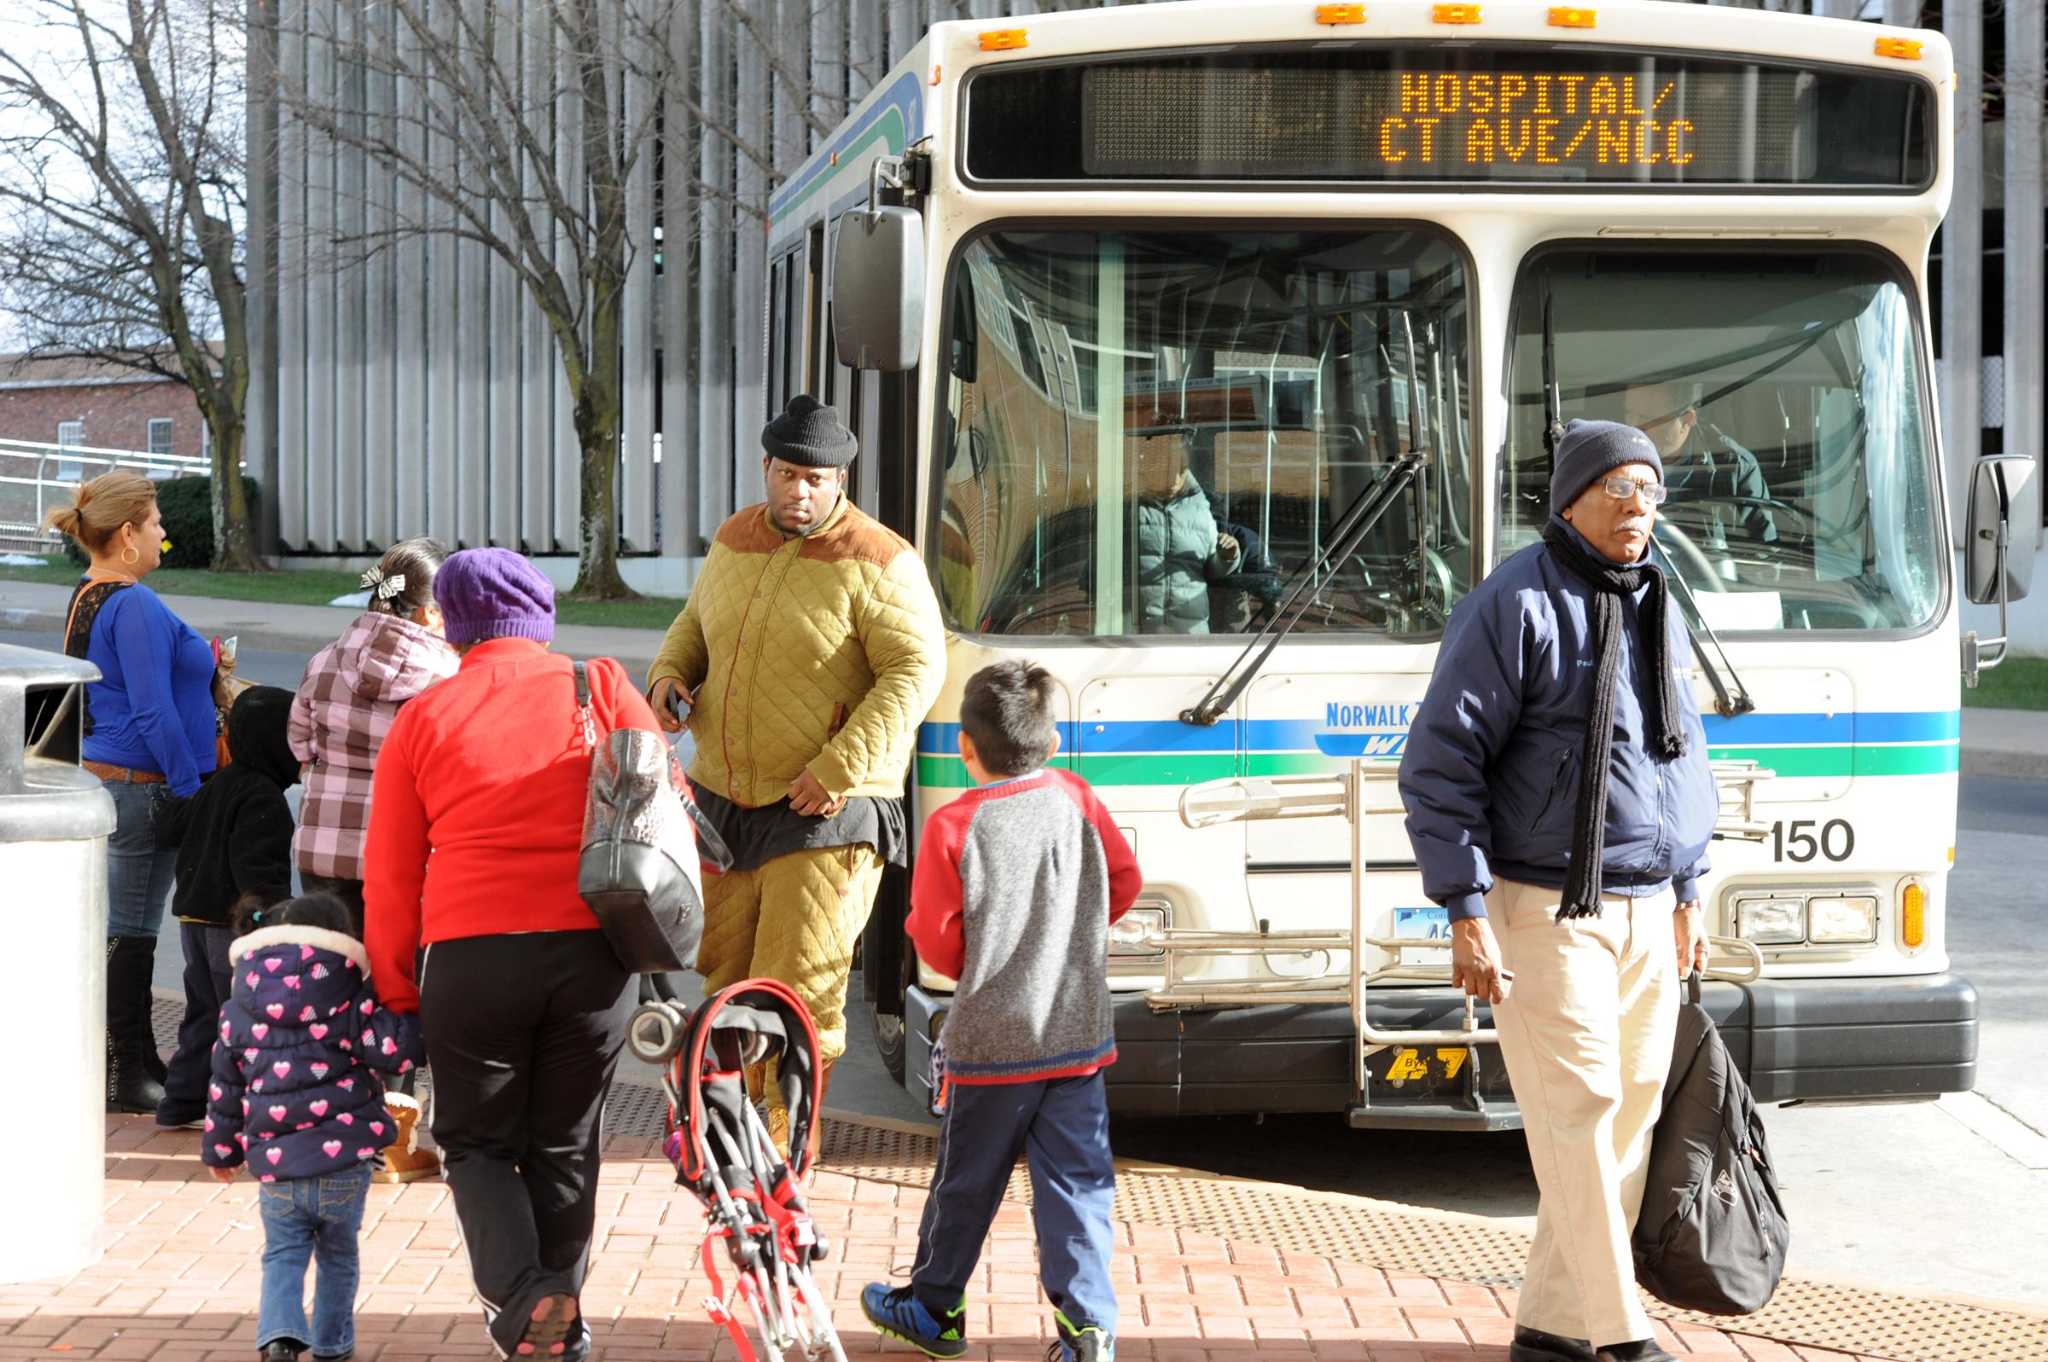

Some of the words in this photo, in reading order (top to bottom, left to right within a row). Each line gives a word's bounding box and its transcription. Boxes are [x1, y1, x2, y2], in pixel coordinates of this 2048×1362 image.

[1401, 74, 1675, 115] HOSPITAL/
[1380, 117, 1440, 163] CT
[1467, 118, 1694, 164] AVE/NCC
[1326, 702, 1409, 728] NORWALK
[1770, 818, 1855, 863] 150
